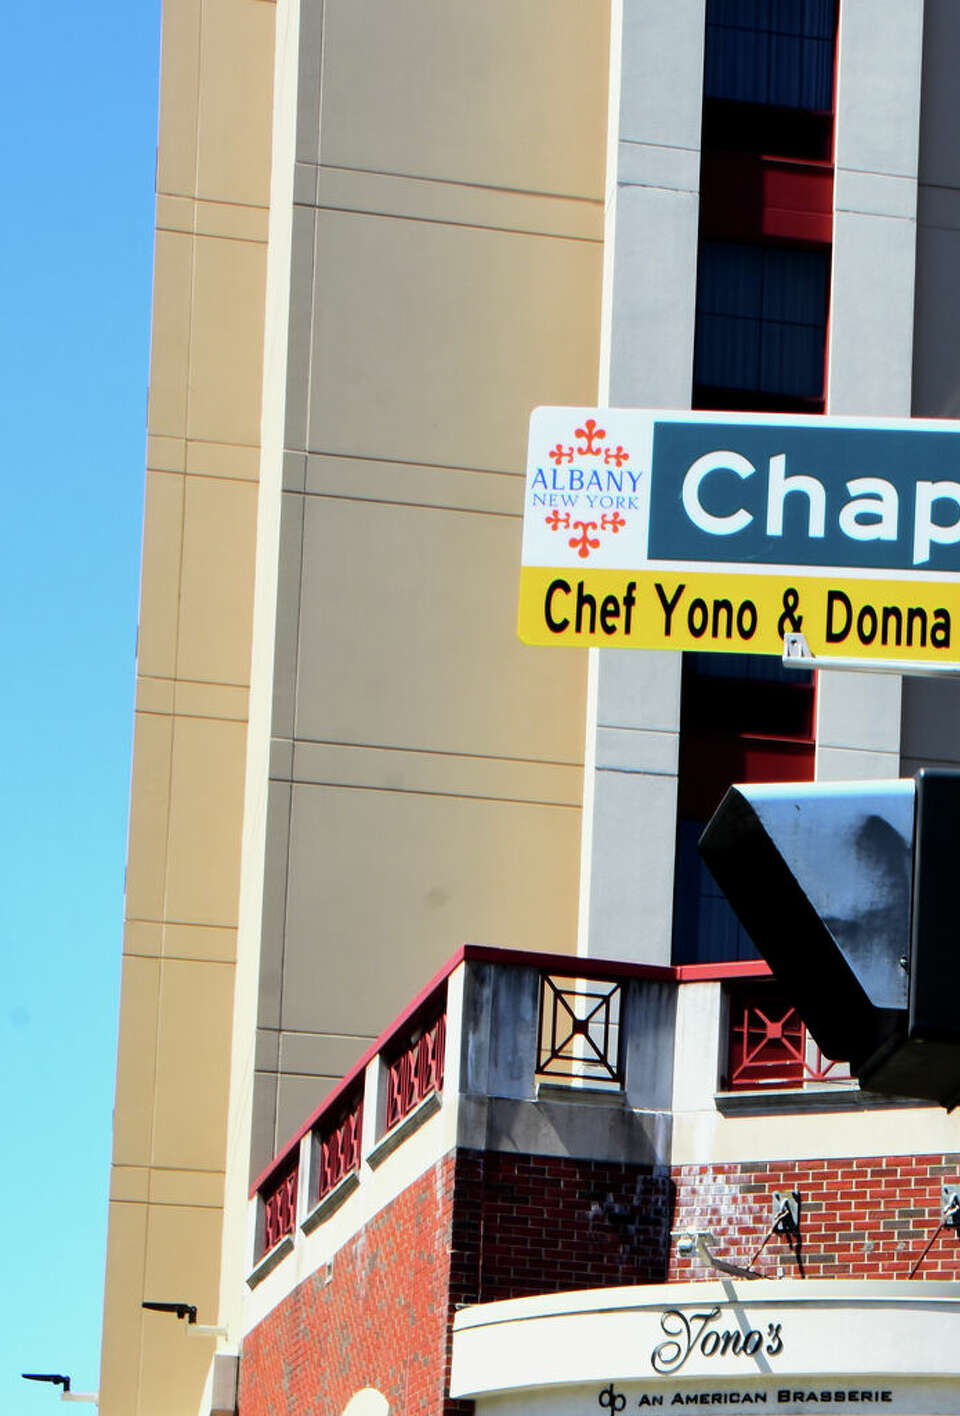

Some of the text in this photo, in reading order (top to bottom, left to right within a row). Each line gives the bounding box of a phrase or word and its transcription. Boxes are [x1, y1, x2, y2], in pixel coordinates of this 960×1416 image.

[531, 467, 643, 493] ALBANY
[532, 493, 640, 510] NEW YORK
[544, 579, 637, 637] Chef
[656, 584, 758, 641] Yono
[776, 594, 804, 638] &
[826, 590, 951, 650] Donna
[651, 1304, 786, 1374] Yono's
